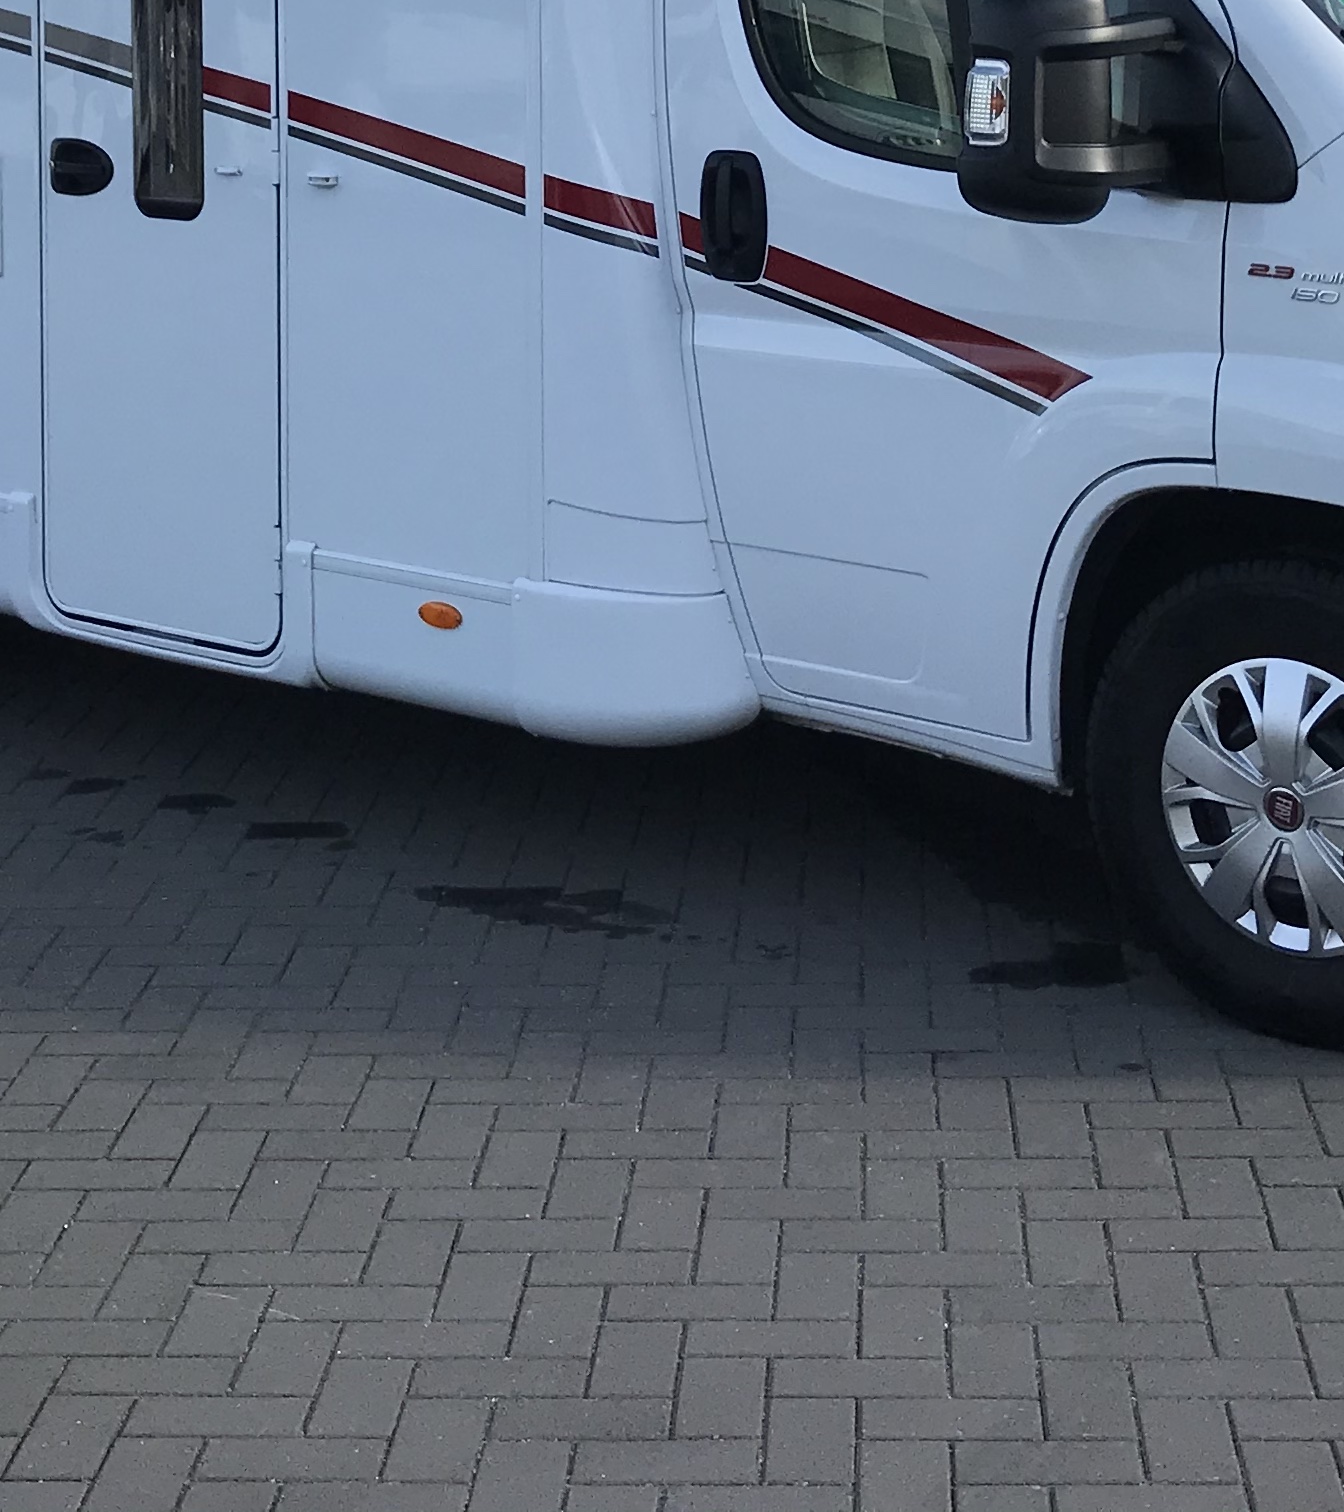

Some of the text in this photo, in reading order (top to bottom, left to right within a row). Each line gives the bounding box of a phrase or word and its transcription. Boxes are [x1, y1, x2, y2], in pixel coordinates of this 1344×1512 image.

[1248, 262, 1295, 280] 2.3
[1290, 287, 1341, 305] 150
[1274, 796, 1293, 823] FIAT
